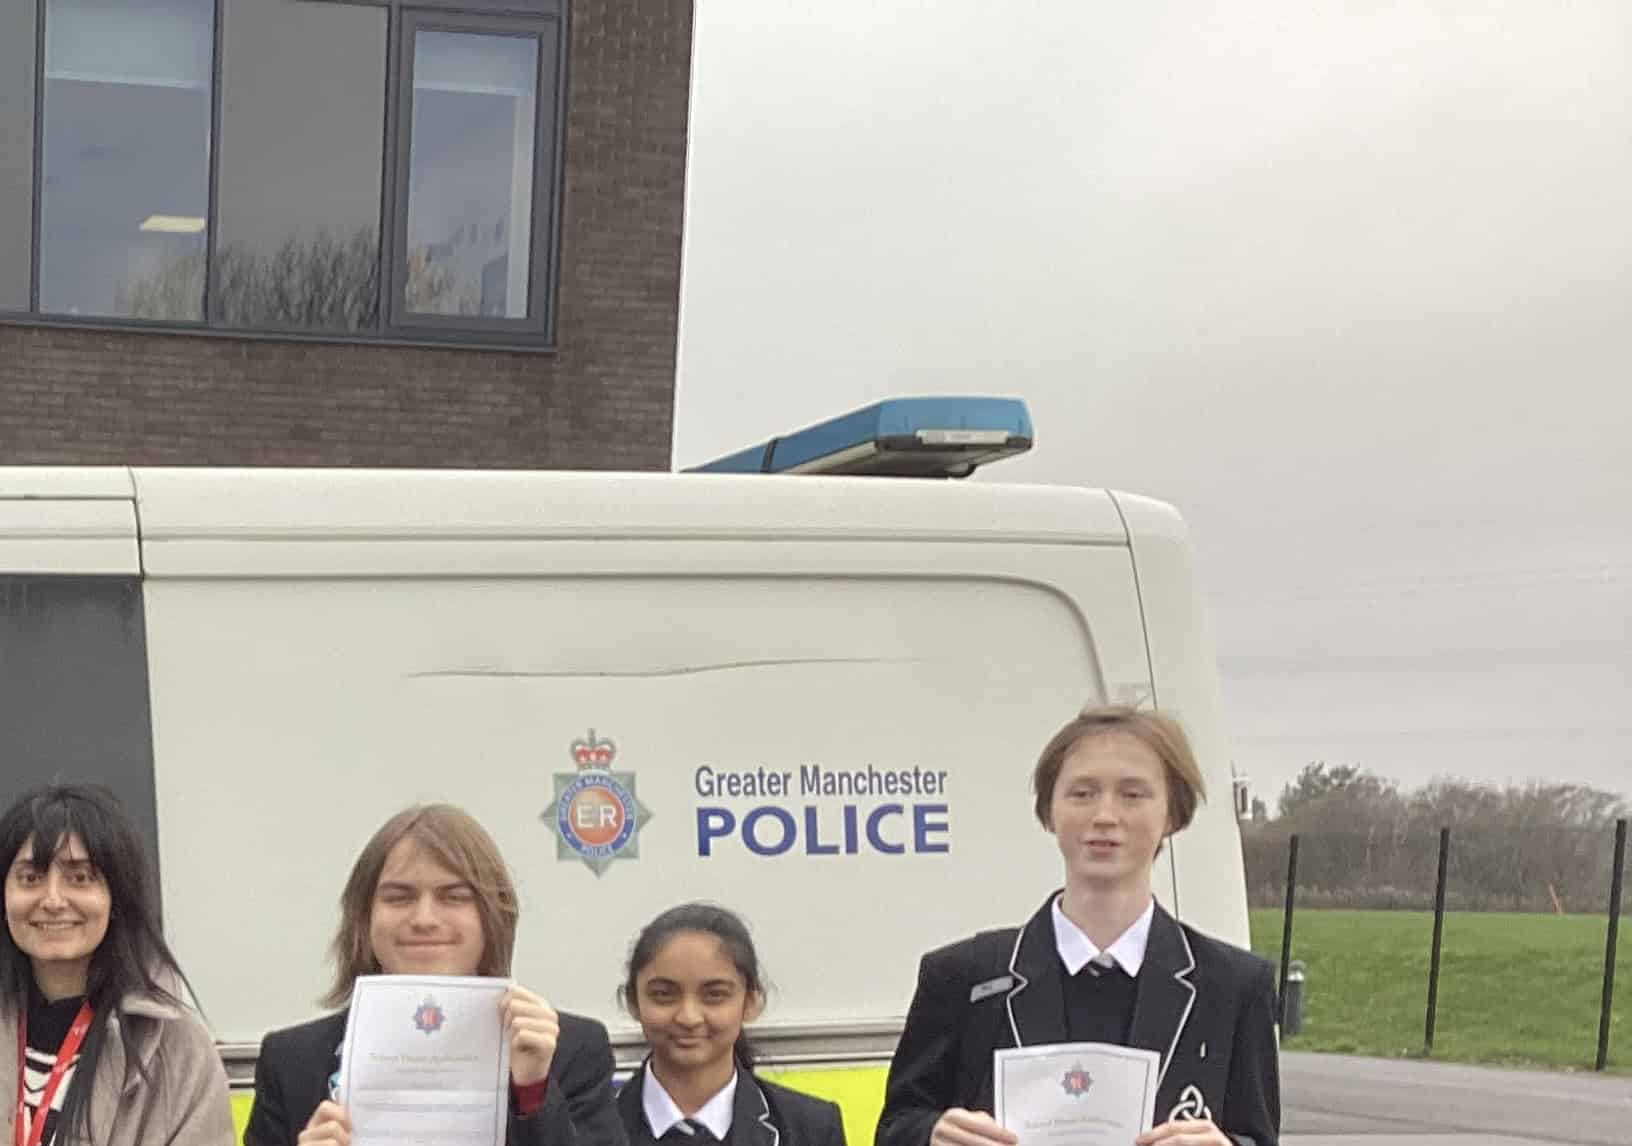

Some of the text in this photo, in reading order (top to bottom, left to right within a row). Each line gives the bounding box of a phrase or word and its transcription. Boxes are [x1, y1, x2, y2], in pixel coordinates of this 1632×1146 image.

[695, 764, 948, 797] Greater Manchester
[576, 804, 617, 829] ER
[696, 803, 950, 857] POLICE
